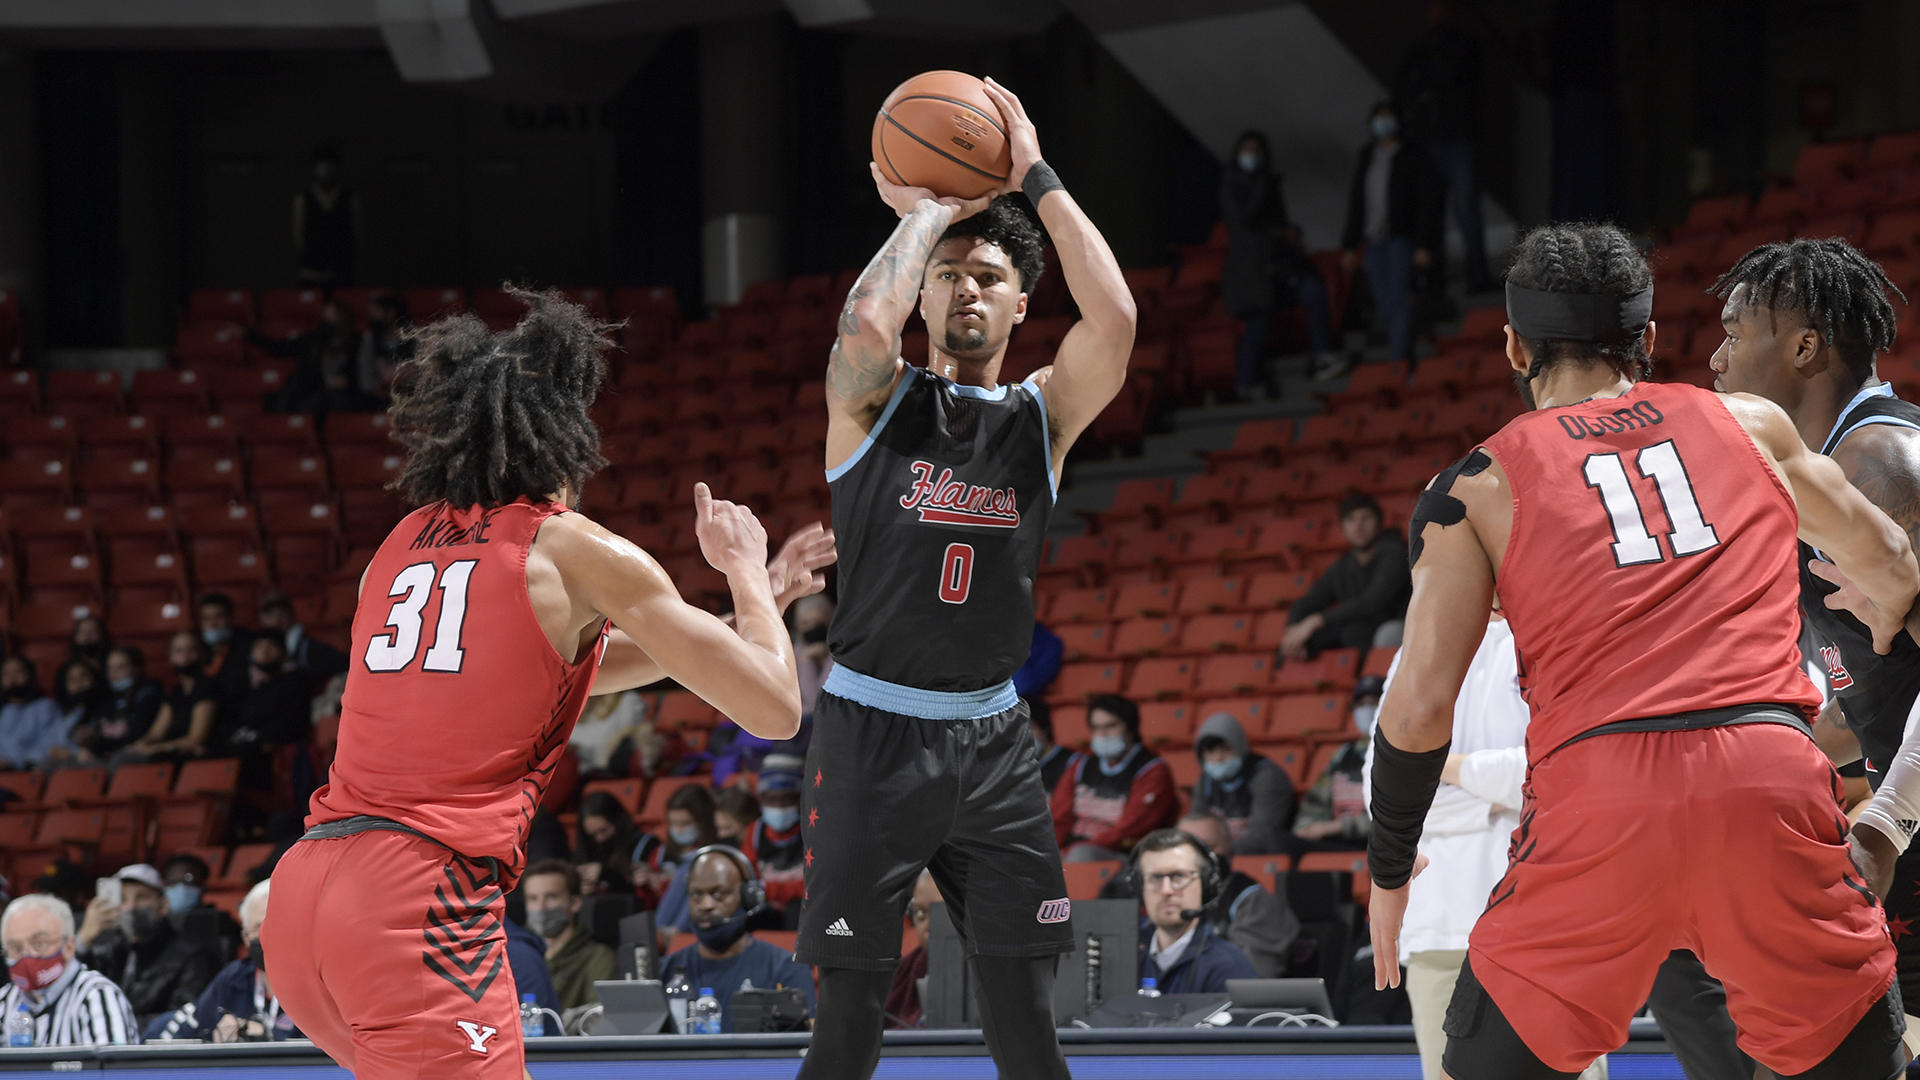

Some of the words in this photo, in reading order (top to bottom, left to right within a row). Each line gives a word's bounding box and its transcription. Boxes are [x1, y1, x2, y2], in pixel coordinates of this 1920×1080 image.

[1557, 400, 1664, 440] OGORO
[900, 460, 1020, 526] Flames
[1581, 438, 1722, 568] 11
[938, 542, 975, 605] 0
[363, 559, 480, 674] 31
[825, 928, 854, 937] adidas
[1038, 898, 1070, 922] UIC
[456, 1019, 498, 1055] Y
